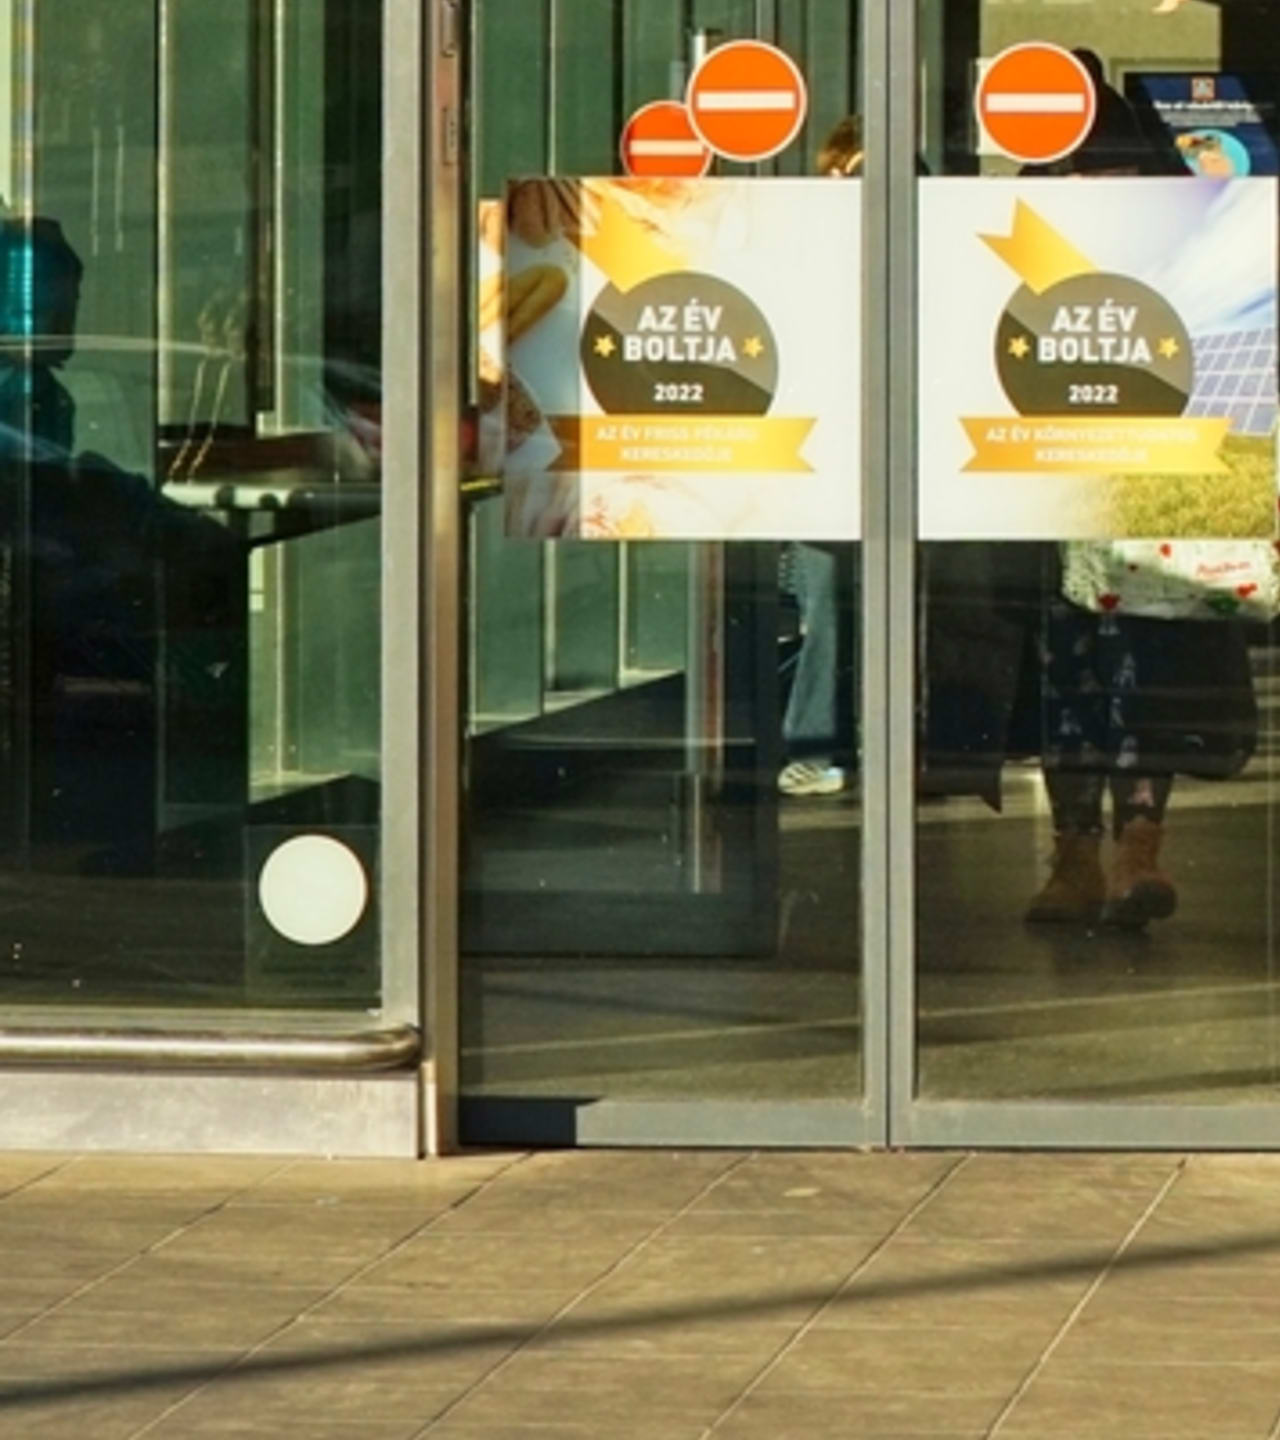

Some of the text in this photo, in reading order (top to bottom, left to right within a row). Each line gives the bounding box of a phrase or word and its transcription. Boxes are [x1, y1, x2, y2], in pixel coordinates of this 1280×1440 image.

[637, 298, 722, 331] AZ ÉV
[1051, 298, 1138, 332] AZ ÉV
[623, 335, 737, 362] BOLTJA
[1037, 336, 1153, 363] BOLTJA
[653, 383, 704, 402] 2022
[1068, 385, 1119, 403] 2022
[596, 426, 617, 441] AZ
[620, 423, 640, 441] ÉV
[985, 426, 1008, 441] AZ
[1011, 424, 1031, 442] ÉV
